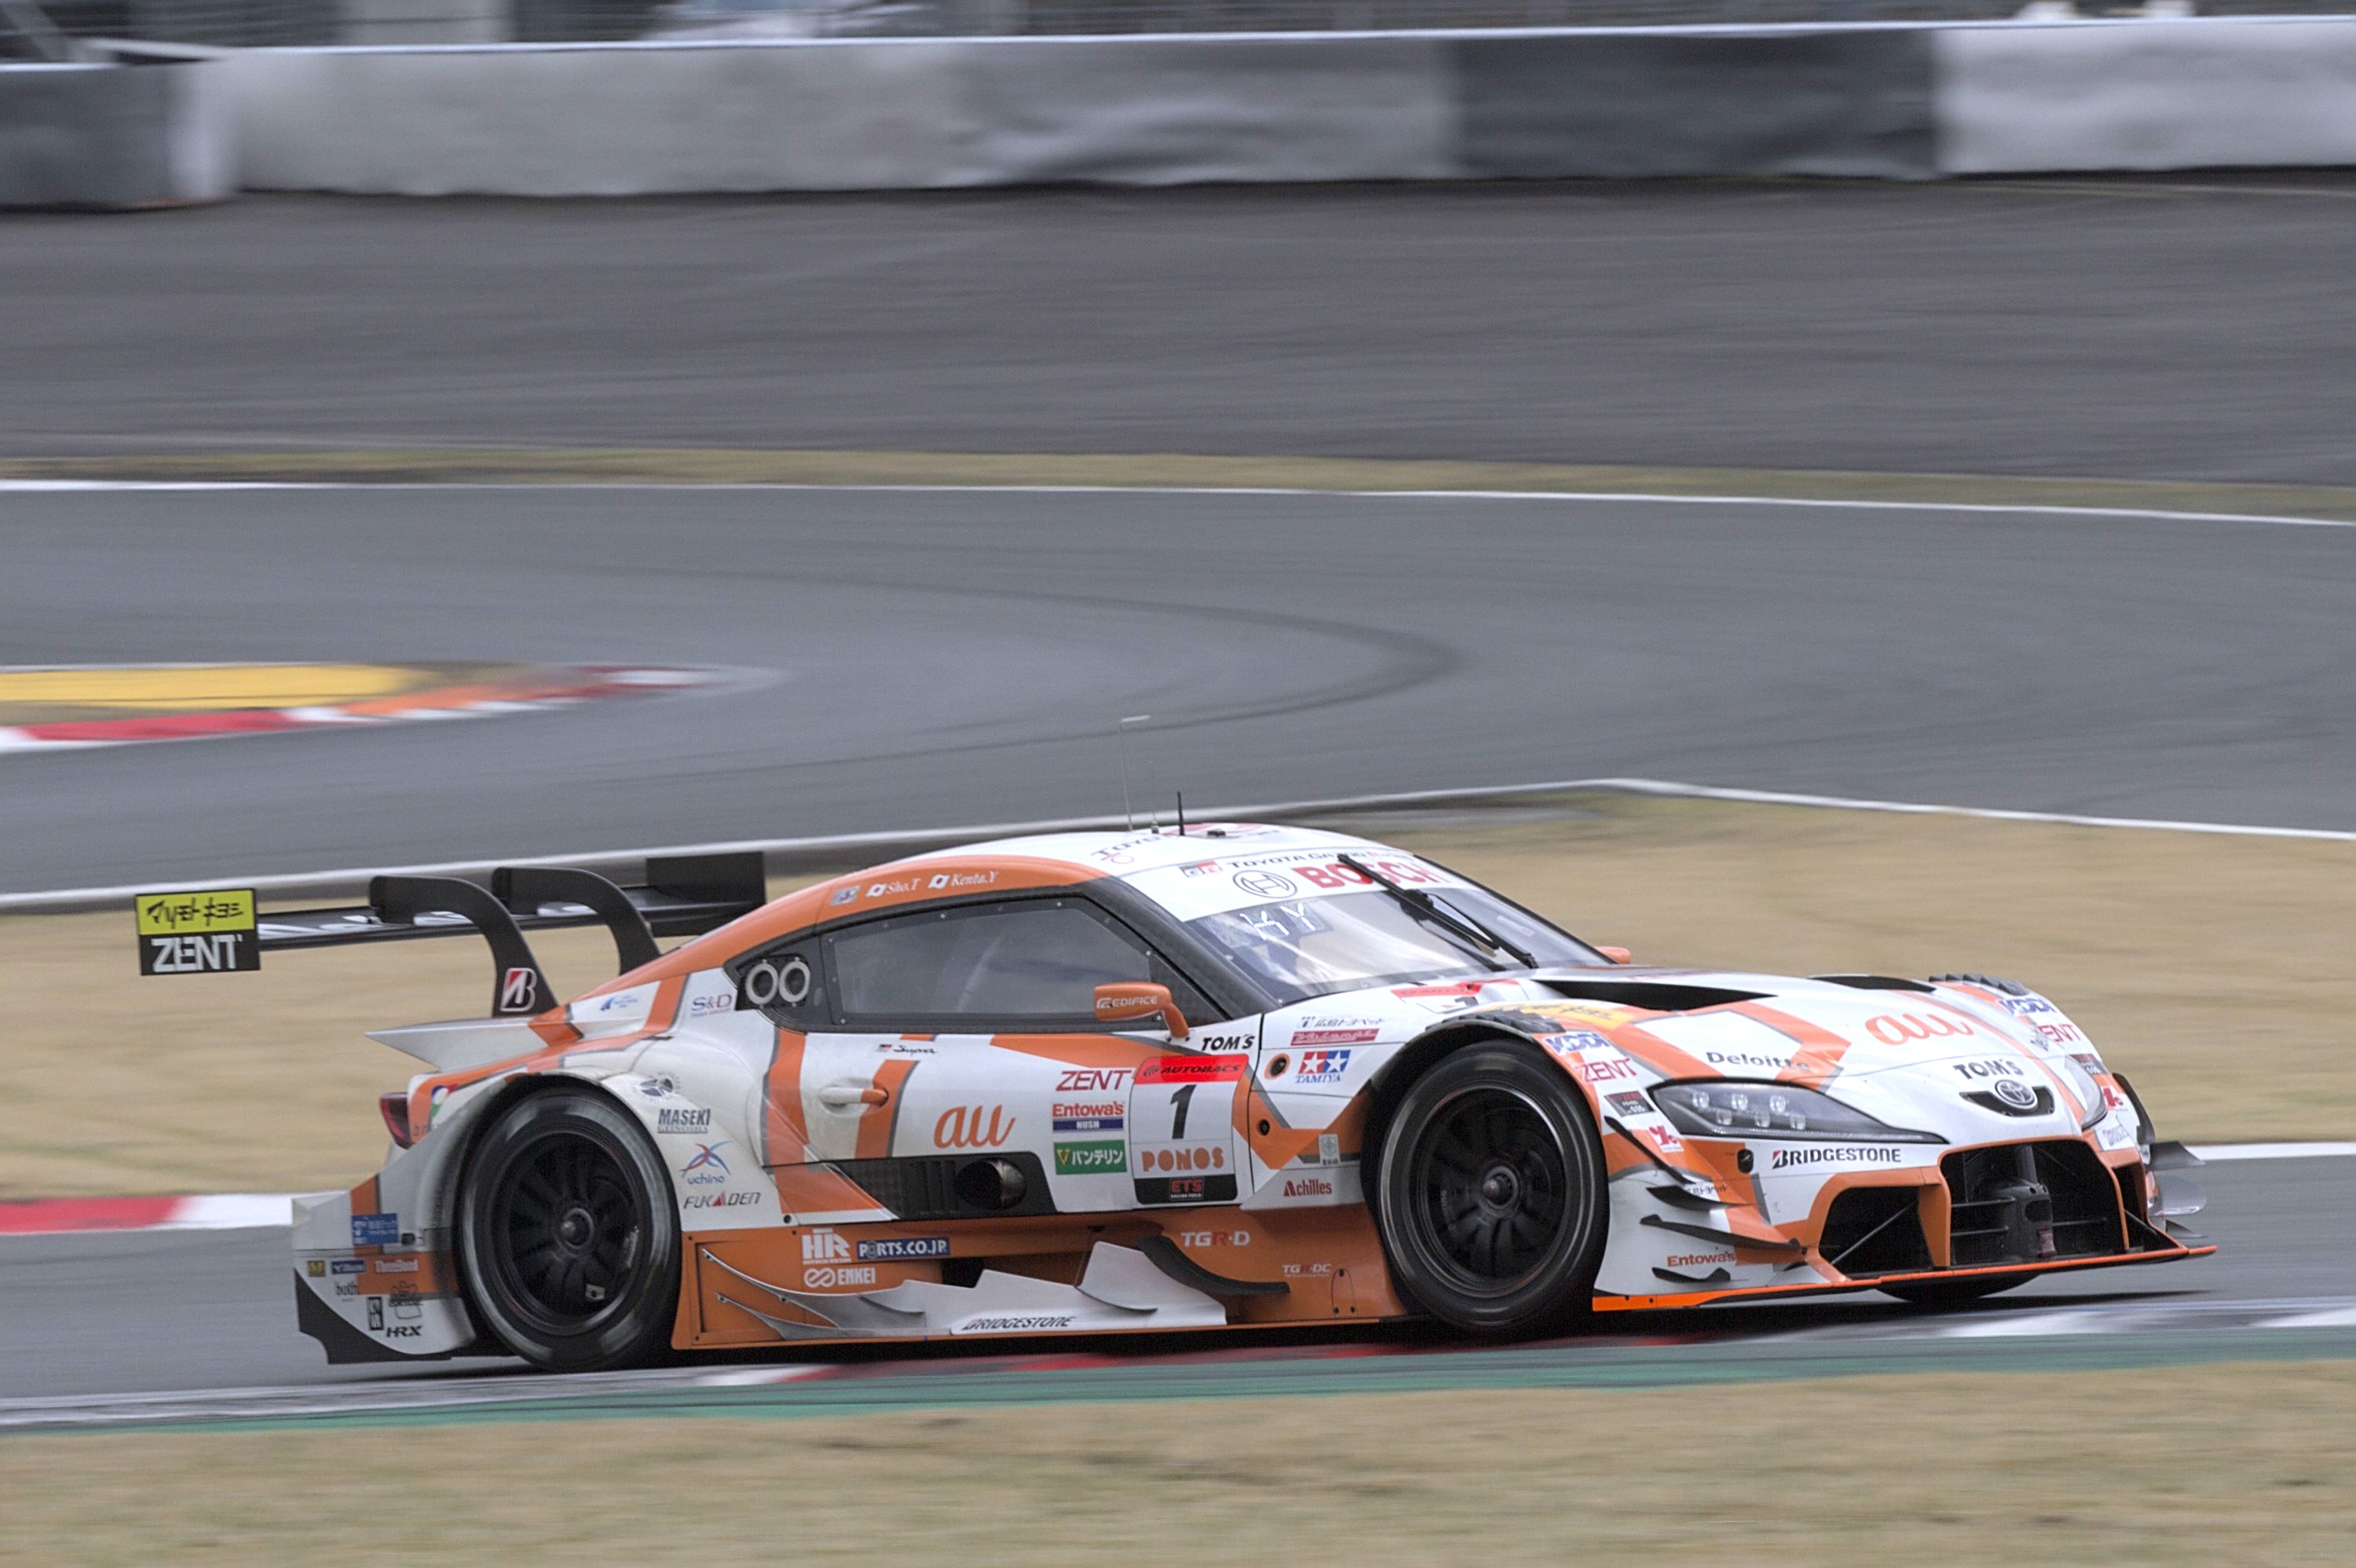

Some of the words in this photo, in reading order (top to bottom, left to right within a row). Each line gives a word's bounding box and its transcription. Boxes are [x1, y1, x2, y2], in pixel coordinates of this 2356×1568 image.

[150, 934, 237, 973] ZENT
[691, 992, 733, 1011] S&D
[1111, 996, 1158, 1007] EDIFICE
[1864, 1012, 1974, 1046] au
[1202, 1033, 1256, 1051] TOM'S
[1161, 1063, 1242, 1074] AUTOBACS
[1574, 1057, 1637, 1083] ZENT
[1705, 1051, 1811, 1071] Deloitte
[1952, 1058, 2025, 1080] TOM'S
[1055, 1069, 1132, 1092] ZENT
[1296, 1073, 1341, 1084] TAMIYA
[657, 1108, 712, 1127] MASEKI
[1052, 1100, 1125, 1117] Entowa's
[1169, 1084, 1198, 1140] 1
[933, 1104, 1017, 1150] au
[1071, 1148, 1124, 1166] バンテリン
[1140, 1146, 1225, 1173] PONOS
[1771, 1148, 1902, 1170] BRIDGESTONE
[686, 1171, 726, 1185] uchino
[1282, 1179, 1333, 1198] Achilles
[682, 1191, 762, 1210] FUKADEN
[1666, 1251, 1736, 1267] Entowa's
[837, 1266, 876, 1286] ENKEI
[386, 1325, 423, 1338] HRX
[961, 1316, 1076, 1331] BRIDGESTONE
